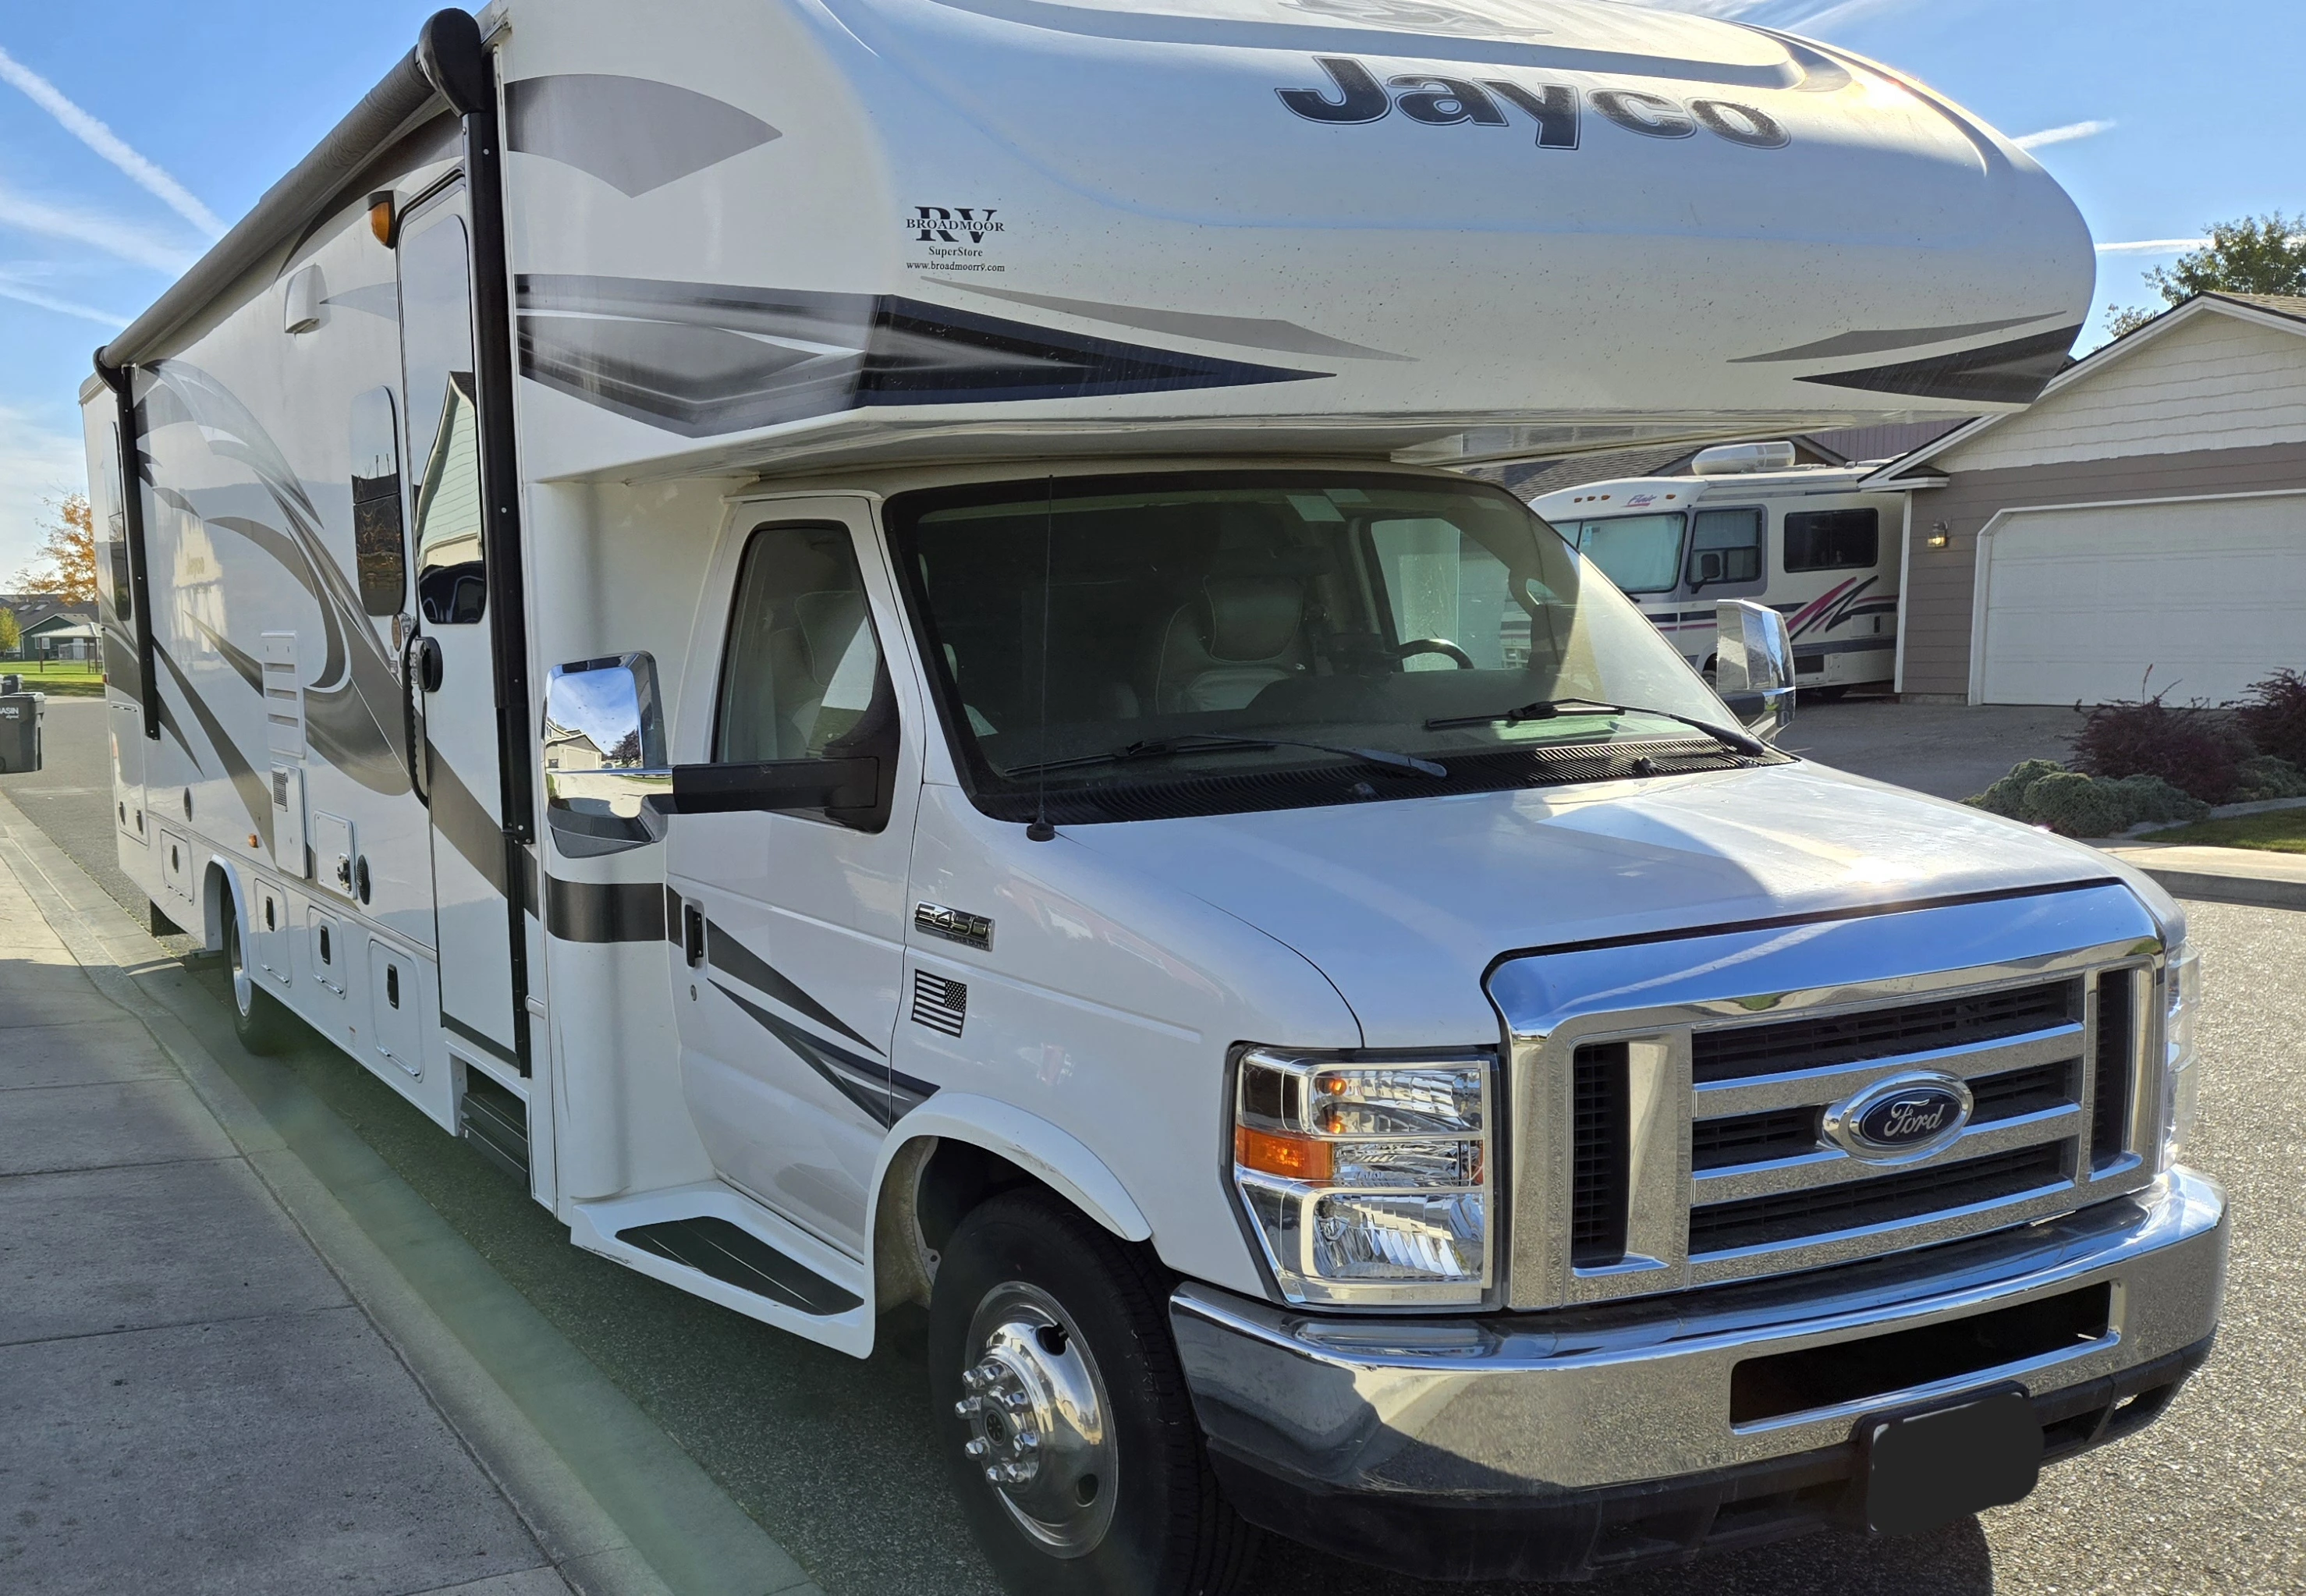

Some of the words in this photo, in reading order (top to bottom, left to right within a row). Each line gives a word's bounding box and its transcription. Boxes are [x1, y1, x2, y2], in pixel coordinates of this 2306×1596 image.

[1274, 55, 1791, 151] Jayco
[906, 218, 1005, 232] BROADMOOR
[914, 206, 997, 243] RV
[928, 246, 983, 257] SuperStore
[1884, 1098, 1945, 1137] Ford
